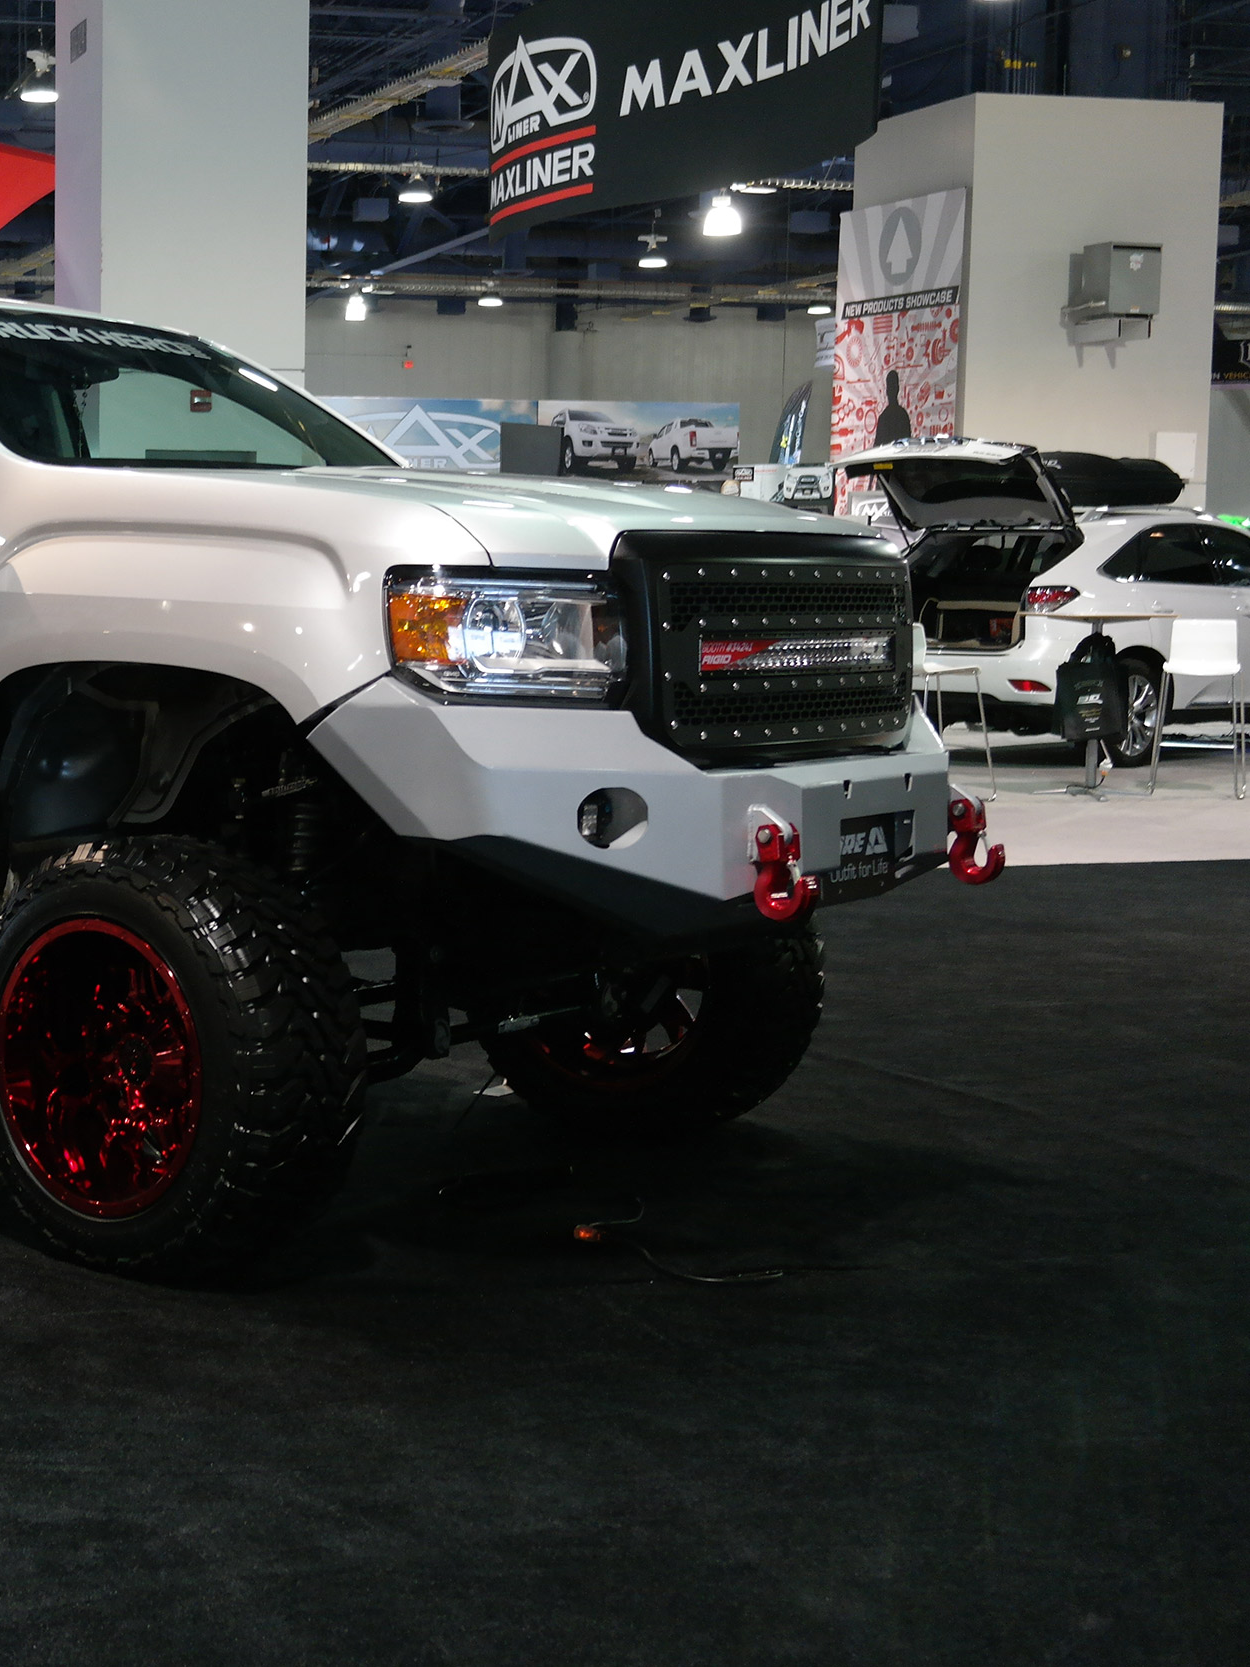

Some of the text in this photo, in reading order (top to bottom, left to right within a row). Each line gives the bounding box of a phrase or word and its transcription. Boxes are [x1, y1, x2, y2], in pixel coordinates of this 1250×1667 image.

[507, 114, 540, 144] LINER
[490, 143, 595, 210] MAXLINER
[845, 289, 954, 317] NEW PRODUCTS SHOWCASE
[701, 655, 732, 665] RIGID
